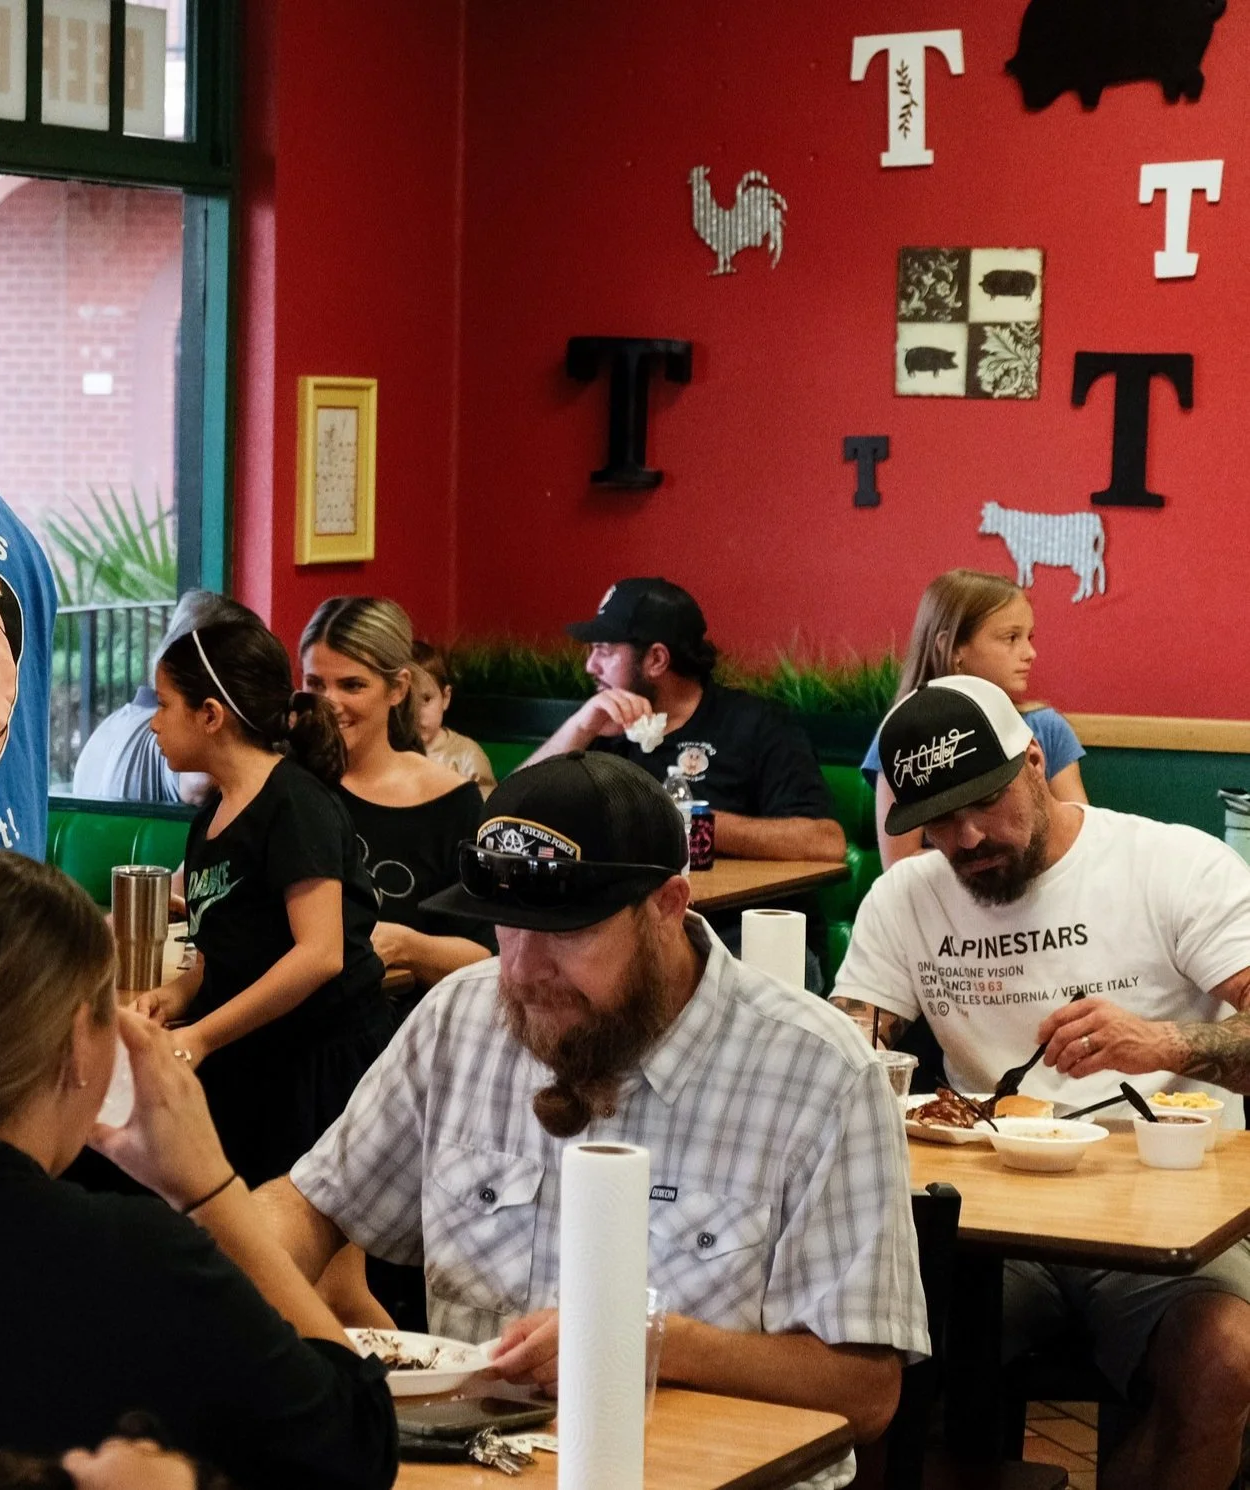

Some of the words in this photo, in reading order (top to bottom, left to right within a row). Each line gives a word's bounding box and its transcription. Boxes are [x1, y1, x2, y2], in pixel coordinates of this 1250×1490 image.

[850, 29, 964, 167] T
[1139, 160, 1224, 279] T
[566, 336, 693, 490] T
[1071, 351, 1194, 509] T
[519, 823, 552, 842] PSYCHIC
[550, 834, 576, 857] FORCE
[938, 923, 1088, 959] ALPINESTARS
[973, 981, 1003, 992] 1963
[987, 965, 1024, 978] VISION
[936, 988, 981, 1005] ANELES
[983, 990, 1049, 1006] CALIFORNIA
[1061, 982, 1103, 998] VENICE
[1107, 976, 1139, 991] ITALY
